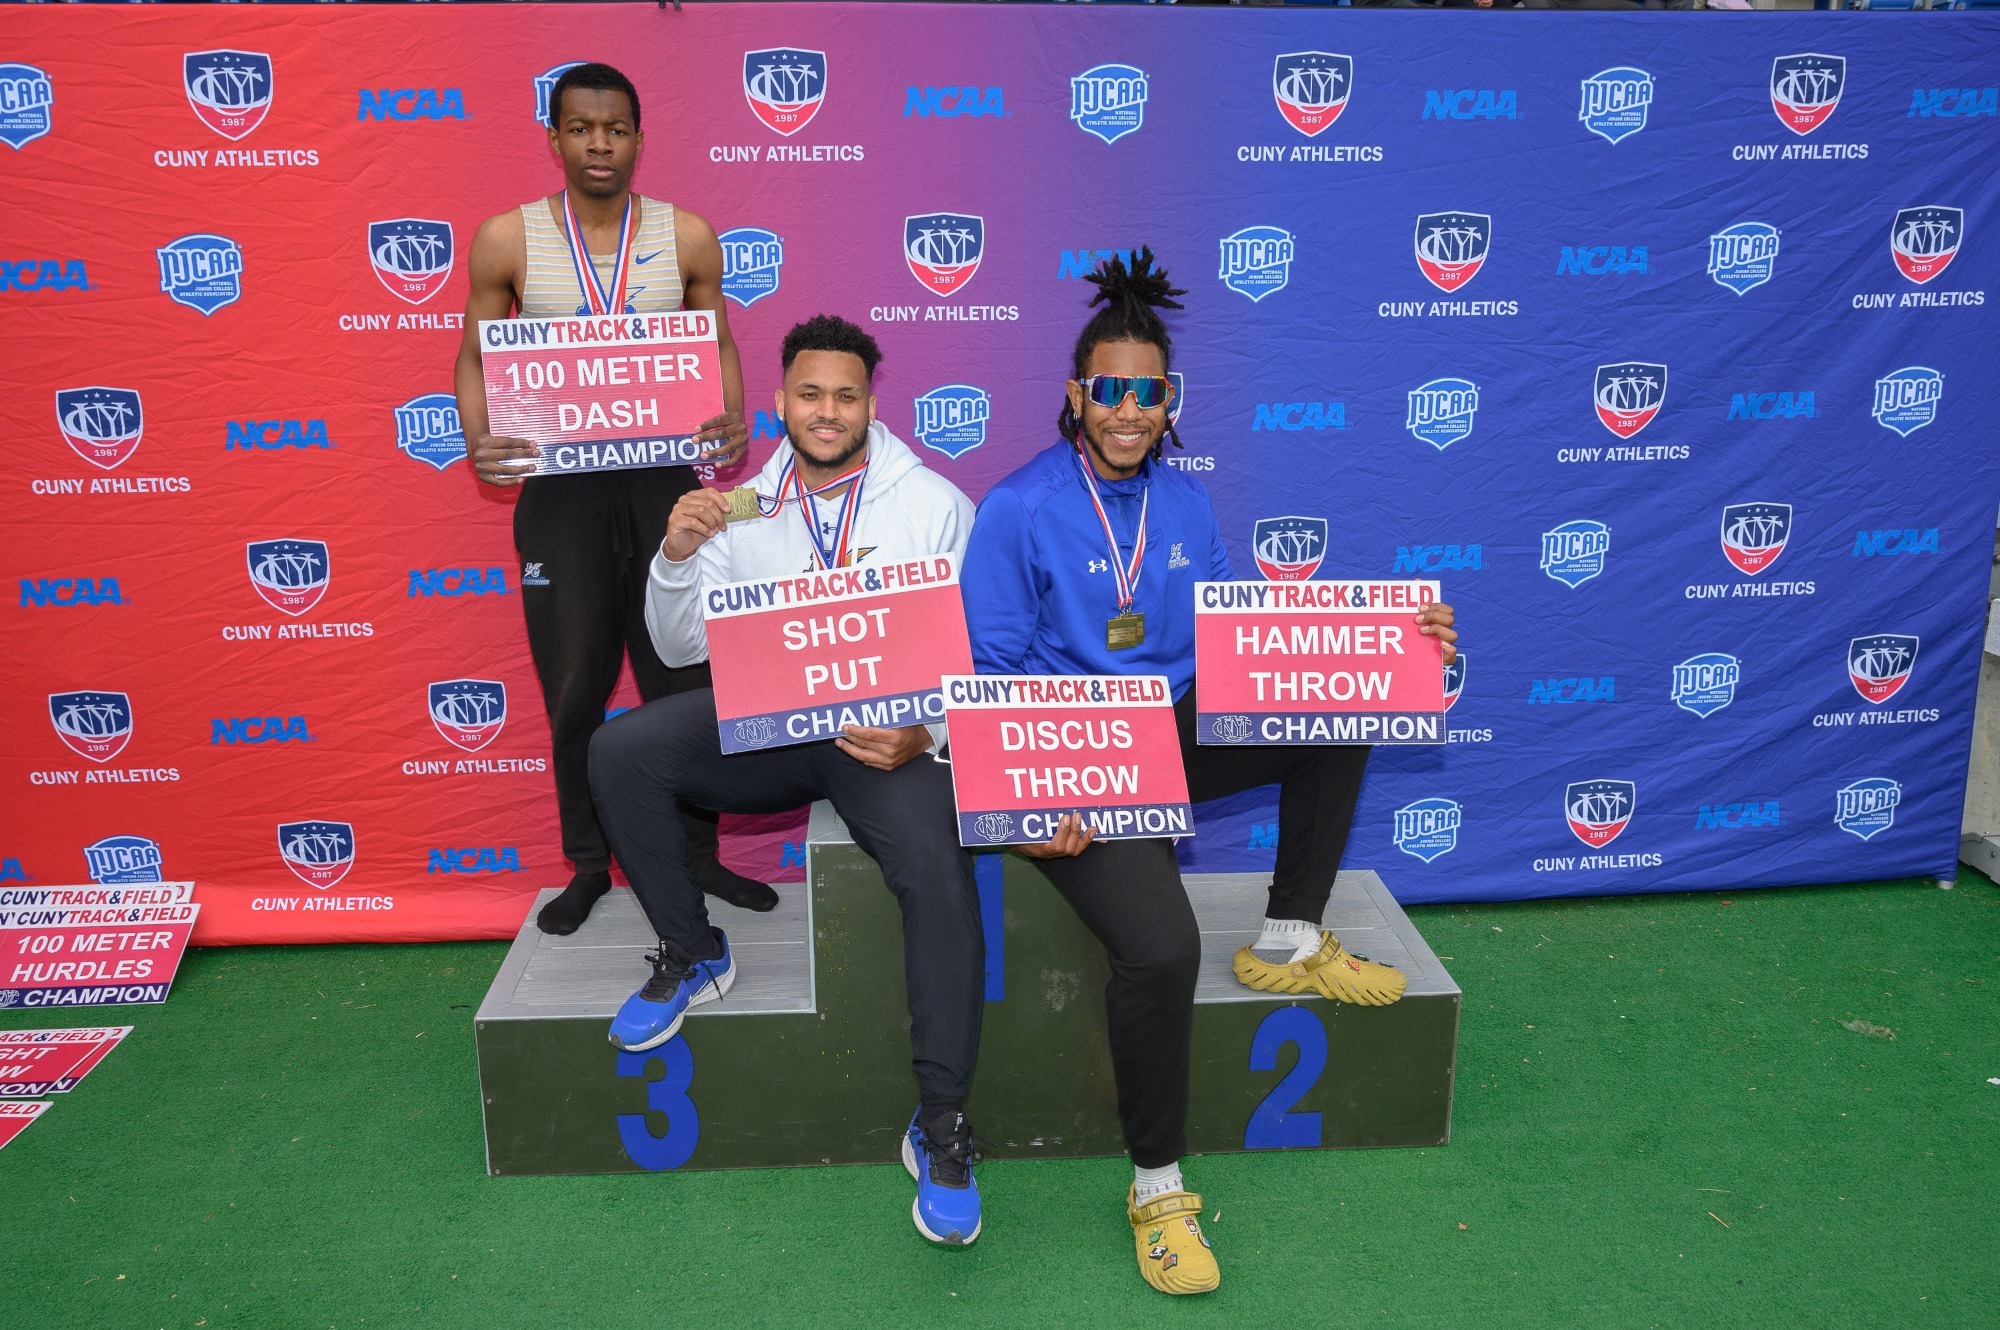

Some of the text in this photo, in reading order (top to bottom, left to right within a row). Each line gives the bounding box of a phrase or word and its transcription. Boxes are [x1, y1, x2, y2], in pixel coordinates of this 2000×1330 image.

[0, 80, 51, 111] CAA
[357, 89, 464, 120] NCAA
[903, 87, 1004, 117] NCAA
[1072, 79, 1146, 117] NJCAA
[1421, 90, 1516, 120] NCAA
[1580, 81, 1652, 118] NJCAA
[1907, 88, 1998, 118] NCAA
[221, 118, 246, 126] 1987
[774, 114, 798, 122] 1987
[1300, 116, 1323, 124] 1987
[1794, 114, 1815, 124] 1987
[155, 150, 319, 166] CUNY ATHLETICS
[710, 145, 864, 162] CUNY ATHLETICS
[1238, 146, 1383, 161] CUNY ATHLETICS
[1733, 144, 1868, 160] CUNY ATHLETICS
[722, 243, 781, 277] JCAA
[1220, 240, 1292, 277] NJCAA
[1556, 246, 1648, 275] NCAA
[1708, 236, 1778, 272] NJCAA
[159, 250, 241, 289] NJCAA
[933, 275, 956, 284] 1987
[1440, 272, 1462, 280] 1987
[1910, 264, 1933, 272] 1987
[404, 283, 426, 292] 1987
[1853, 291, 1984, 308] CUNY ATHLETICS
[339, 313, 465, 330] CUNY ATHLET
[871, 306, 1019, 321] CUNY ATHLETICS
[1379, 301, 1518, 317] CUNY ATHLETICS
[486, 315, 710, 346] CUNYTRACK&FIELD
[505, 353, 703, 392] 100 METER
[1408, 391, 1477, 427] NJCAA
[1727, 391, 1814, 420] NCAA
[1873, 380, 1941, 415] NJCAA
[397, 408, 460, 446] NJCA
[558, 398, 659, 432] DASH
[917, 399, 988, 435] NJCAA
[1252, 402, 1345, 431] NCAA
[1617, 419, 1638, 428] 1987
[225, 420, 328, 450] NCAA
[94, 448, 118, 457] 1987
[1167, 456, 1215, 471] ETICS
[1558, 446, 1689, 462] CUNY ATHLETICS
[32, 477, 190, 494] CUNY ATHLETICS
[1541, 532, 1608, 568] NJCAA
[1852, 528, 1939, 557] NCAA
[1392, 544, 1482, 572] NCAA
[1743, 556, 1763, 565] 1987
[407, 568, 506, 597] NCAA
[708, 558, 951, 613] CUNYTRACK&FIELD
[1278, 572, 1300, 580] 1987
[19, 577, 123, 607] NCAA
[282, 596, 305, 605] 1987
[1202, 585, 1434, 608] CUNYTRACK&FIELD
[1685, 581, 1815, 598] CUNY ATHLETICS
[223, 623, 373, 640] CUNY ATHLETICS
[783, 608, 891, 651] SHOT
[1236, 626, 1405, 655] HAMMER
[804, 656, 882, 695] PUT
[1249, 672, 1392, 701] THROW
[1672, 665, 1738, 698] NJCAA
[950, 680, 1165, 703] CUNYTRACK&FIELD
[1528, 677, 1615, 704] NCAA
[1869, 686, 1888, 694] 1987
[786, 693, 945, 738] CHAMPIO
[1261, 716, 1437, 740] CHAMPION
[1813, 709, 1939, 726] CUNY ATHLETICS
[211, 716, 309, 745] NCAA
[460, 734, 482, 742] 1987
[1000, 720, 1133, 751] DISCUS
[1448, 729, 1493, 743] ETICS
[88, 744, 110, 752] 1987
[30, 768, 180, 784] CUNY ATHLETICS
[403, 758, 546, 774] CUNY ATHLETICS
[1005, 765, 1139, 798] THROW
[1695, 801, 1780, 829] NCAA
[1835, 789, 1899, 822] NJCAA
[1394, 809, 1459, 843] NJCAA
[1589, 830, 1608, 838] 1987
[85, 847, 161, 878] NJCAA
[427, 848, 520, 873] NCAA
[1533, 853, 1662, 871] CUNY ATHLETICS
[1, 890, 173, 905] CUNYTRACK&FIELD
[252, 897, 393, 910] CUNY ATHLETICS
[17, 907, 192, 925] CUNYTRACK&FIELD
[18, 931, 173, 954] 100 METER
[10, 959, 154, 983] HURDLES
[23, 985, 163, 1006] CHAMPION
[1245, 1005, 1328, 1149] 2
[617, 1033, 699, 1171] 3
